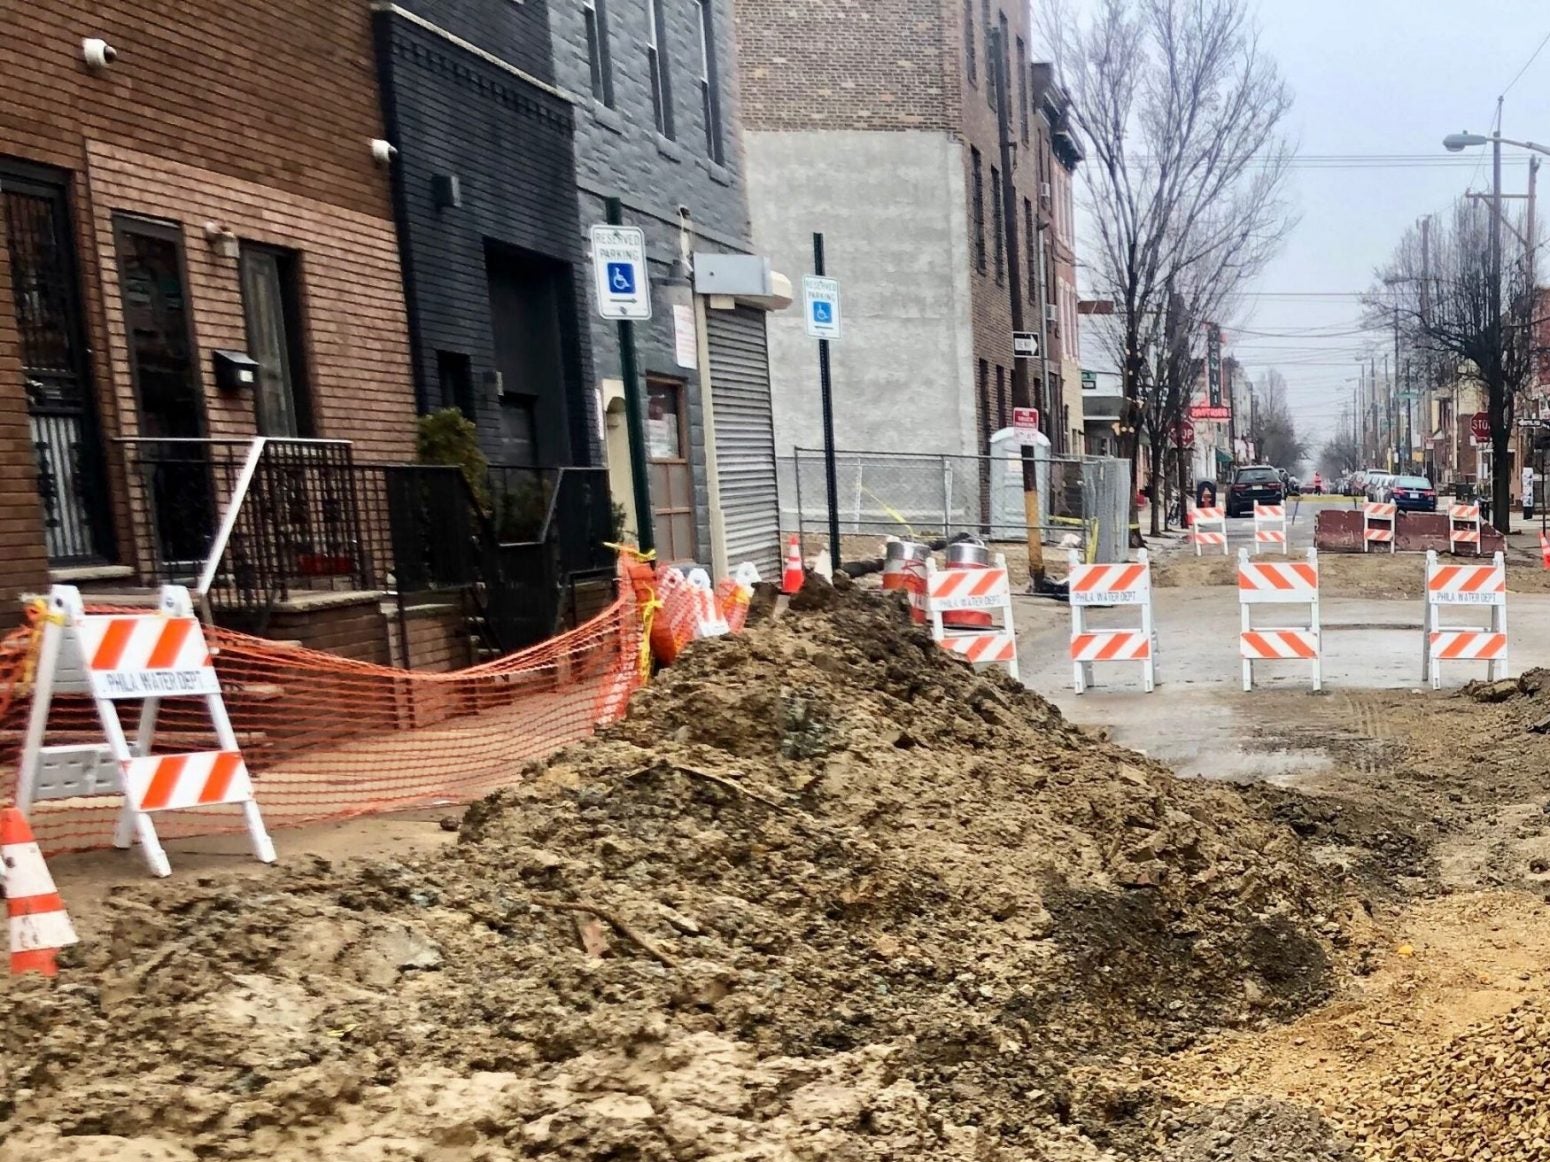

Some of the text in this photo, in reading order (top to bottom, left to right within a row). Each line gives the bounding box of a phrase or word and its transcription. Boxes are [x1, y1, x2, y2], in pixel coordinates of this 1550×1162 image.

[595, 232, 641, 247] RESERVED
[599, 248, 640, 262] PARKING
[1472, 420, 1491, 431] STO
[1458, 591, 1481, 602] WATER
[140, 671, 177, 691] WATER
